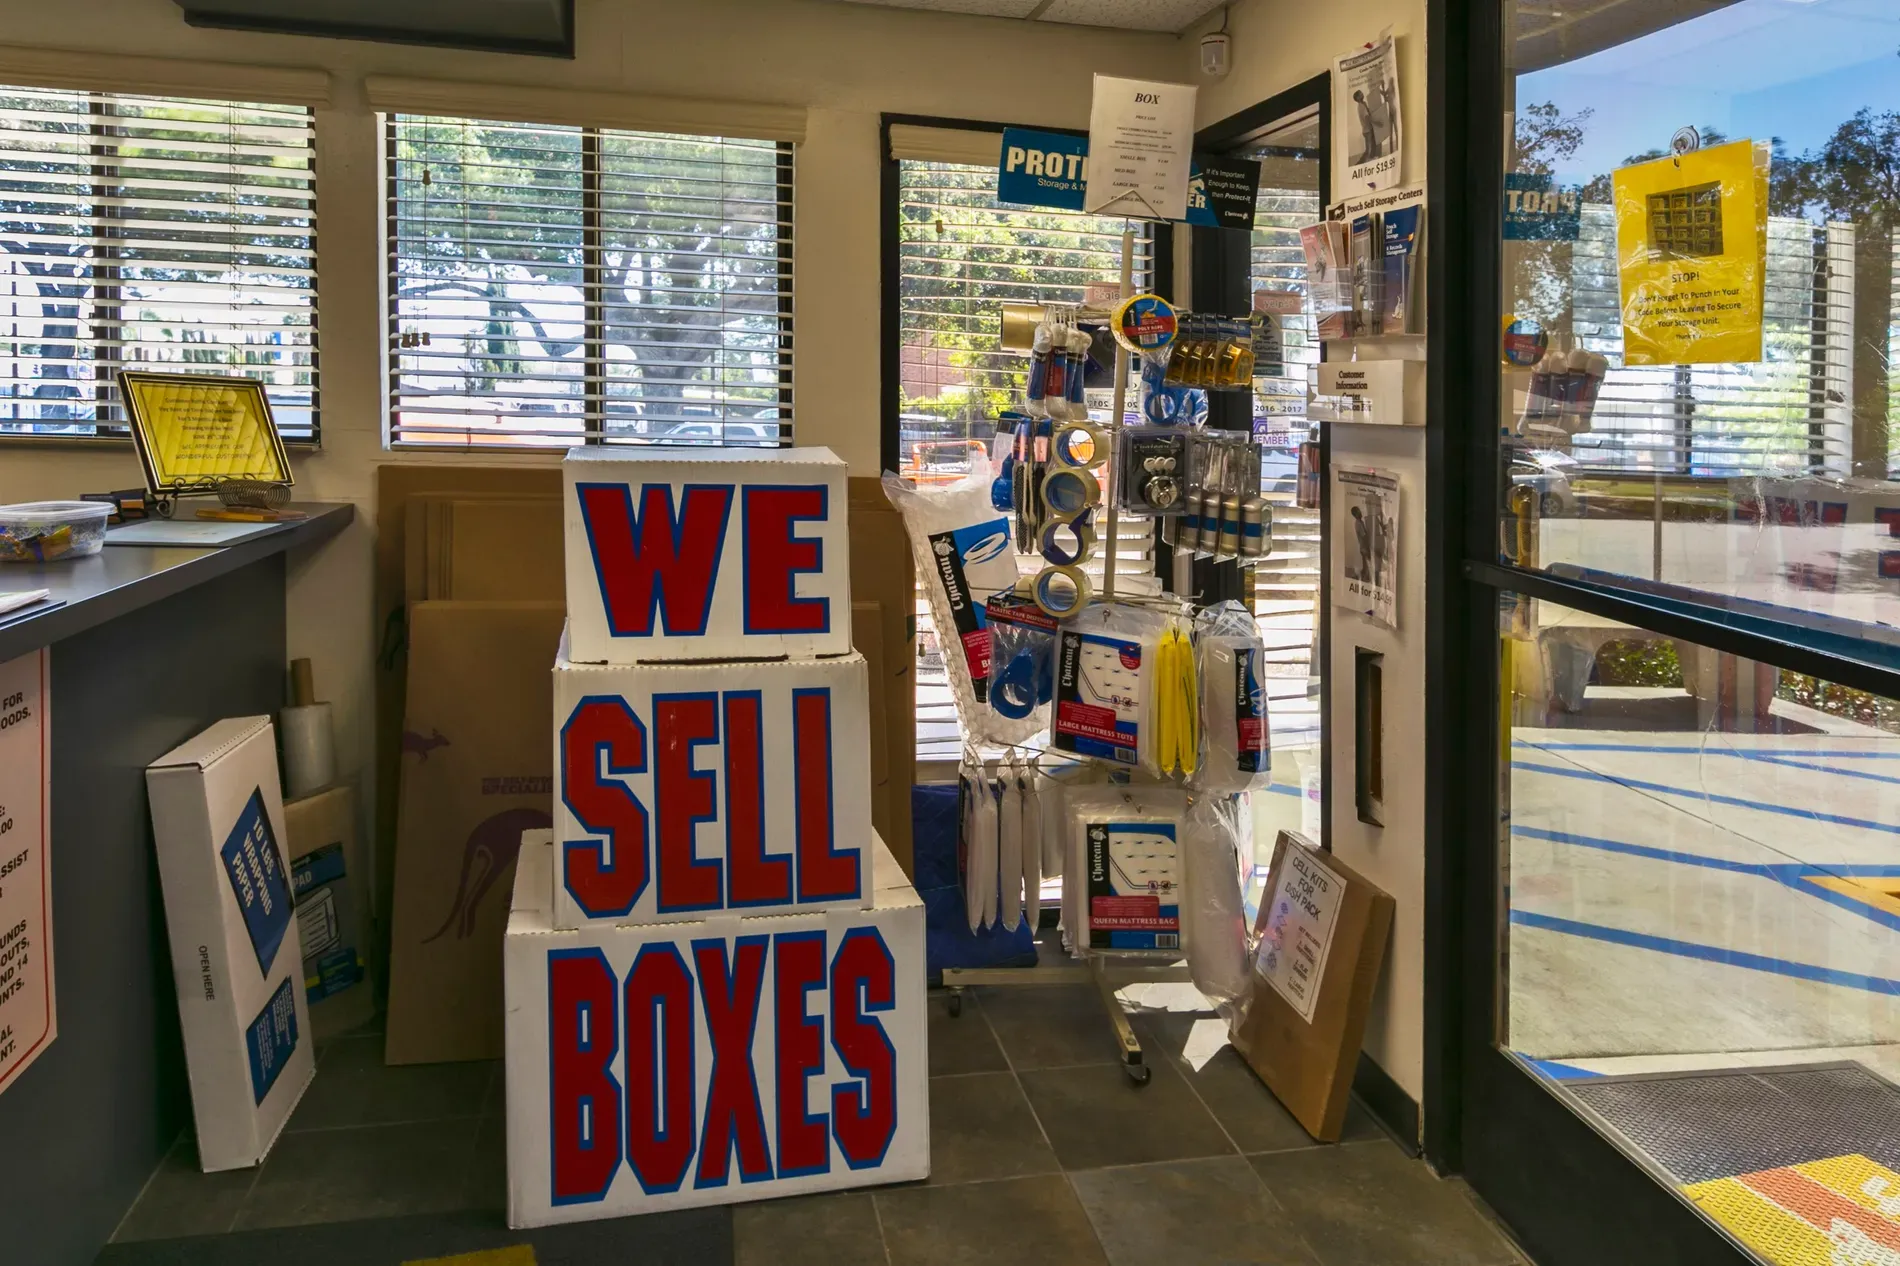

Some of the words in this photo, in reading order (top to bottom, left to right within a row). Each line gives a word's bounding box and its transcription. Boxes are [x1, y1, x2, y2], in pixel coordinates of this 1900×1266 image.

[1134, 92, 1160, 105] BOX
[1038, 178, 1069, 190] Storage
[1208, 180, 1228, 188] Enough
[1220, 170, 1245, 179] Important
[1352, 166, 1362, 180] All
[1364, 165, 1374, 176] for
[1347, 202, 1363, 214] Pouch
[1364, 198, 1376, 209] Self
[1376, 195, 1397, 206] Storage
[1399, 189, 1423, 200] Centers
[1672, 272, 1700, 282] STOP!
[1657, 294, 1678, 302] Forget
[1690, 291, 1712, 299] Punch
[1679, 304, 1705, 313] Leaving
[1717, 302, 1741, 310] Secure
[1336, 381, 1368, 389] Information
[1338, 370, 1365, 378] Customer
[576, 482, 831, 637] WE
[939, 556, 964, 611] Chateau
[1349, 583, 1359, 594] All
[1361, 586, 1371, 596] for
[990, 606, 1011, 615] PLASTIC
[1026, 614, 1053, 625] DISPENSER
[1062, 648, 1074, 687] Chateau
[3, 692, 23, 710] FOR
[0, 707, 31, 730] OODS.
[1059, 719, 1080, 730] LARGE
[1081, 725, 1115, 738] MATTRESS
[1117, 732, 1134, 742] TOTE
[560, 687, 862, 919] SELL
[253, 816, 264, 842] 10
[260, 840, 274, 880] LBS.
[0, 848, 29, 880] SSIST
[1092, 841, 1104, 882] Chateau
[233, 851, 254, 908] PAPER
[244, 832, 272, 915] WRAPPING
[292, 871, 312, 888] PAD
[1292, 857, 1308, 878] CELL
[1310, 872, 1329, 893] KITS
[1298, 878, 1314, 898] FOR
[1285, 882, 1302, 903] DISH
[1300, 897, 1322, 921] PACK
[17, 954, 28, 970] 14
[199, 945, 210, 972] OPEN
[203, 974, 215, 1001] HERE
[546, 926, 897, 1207] BOXES
